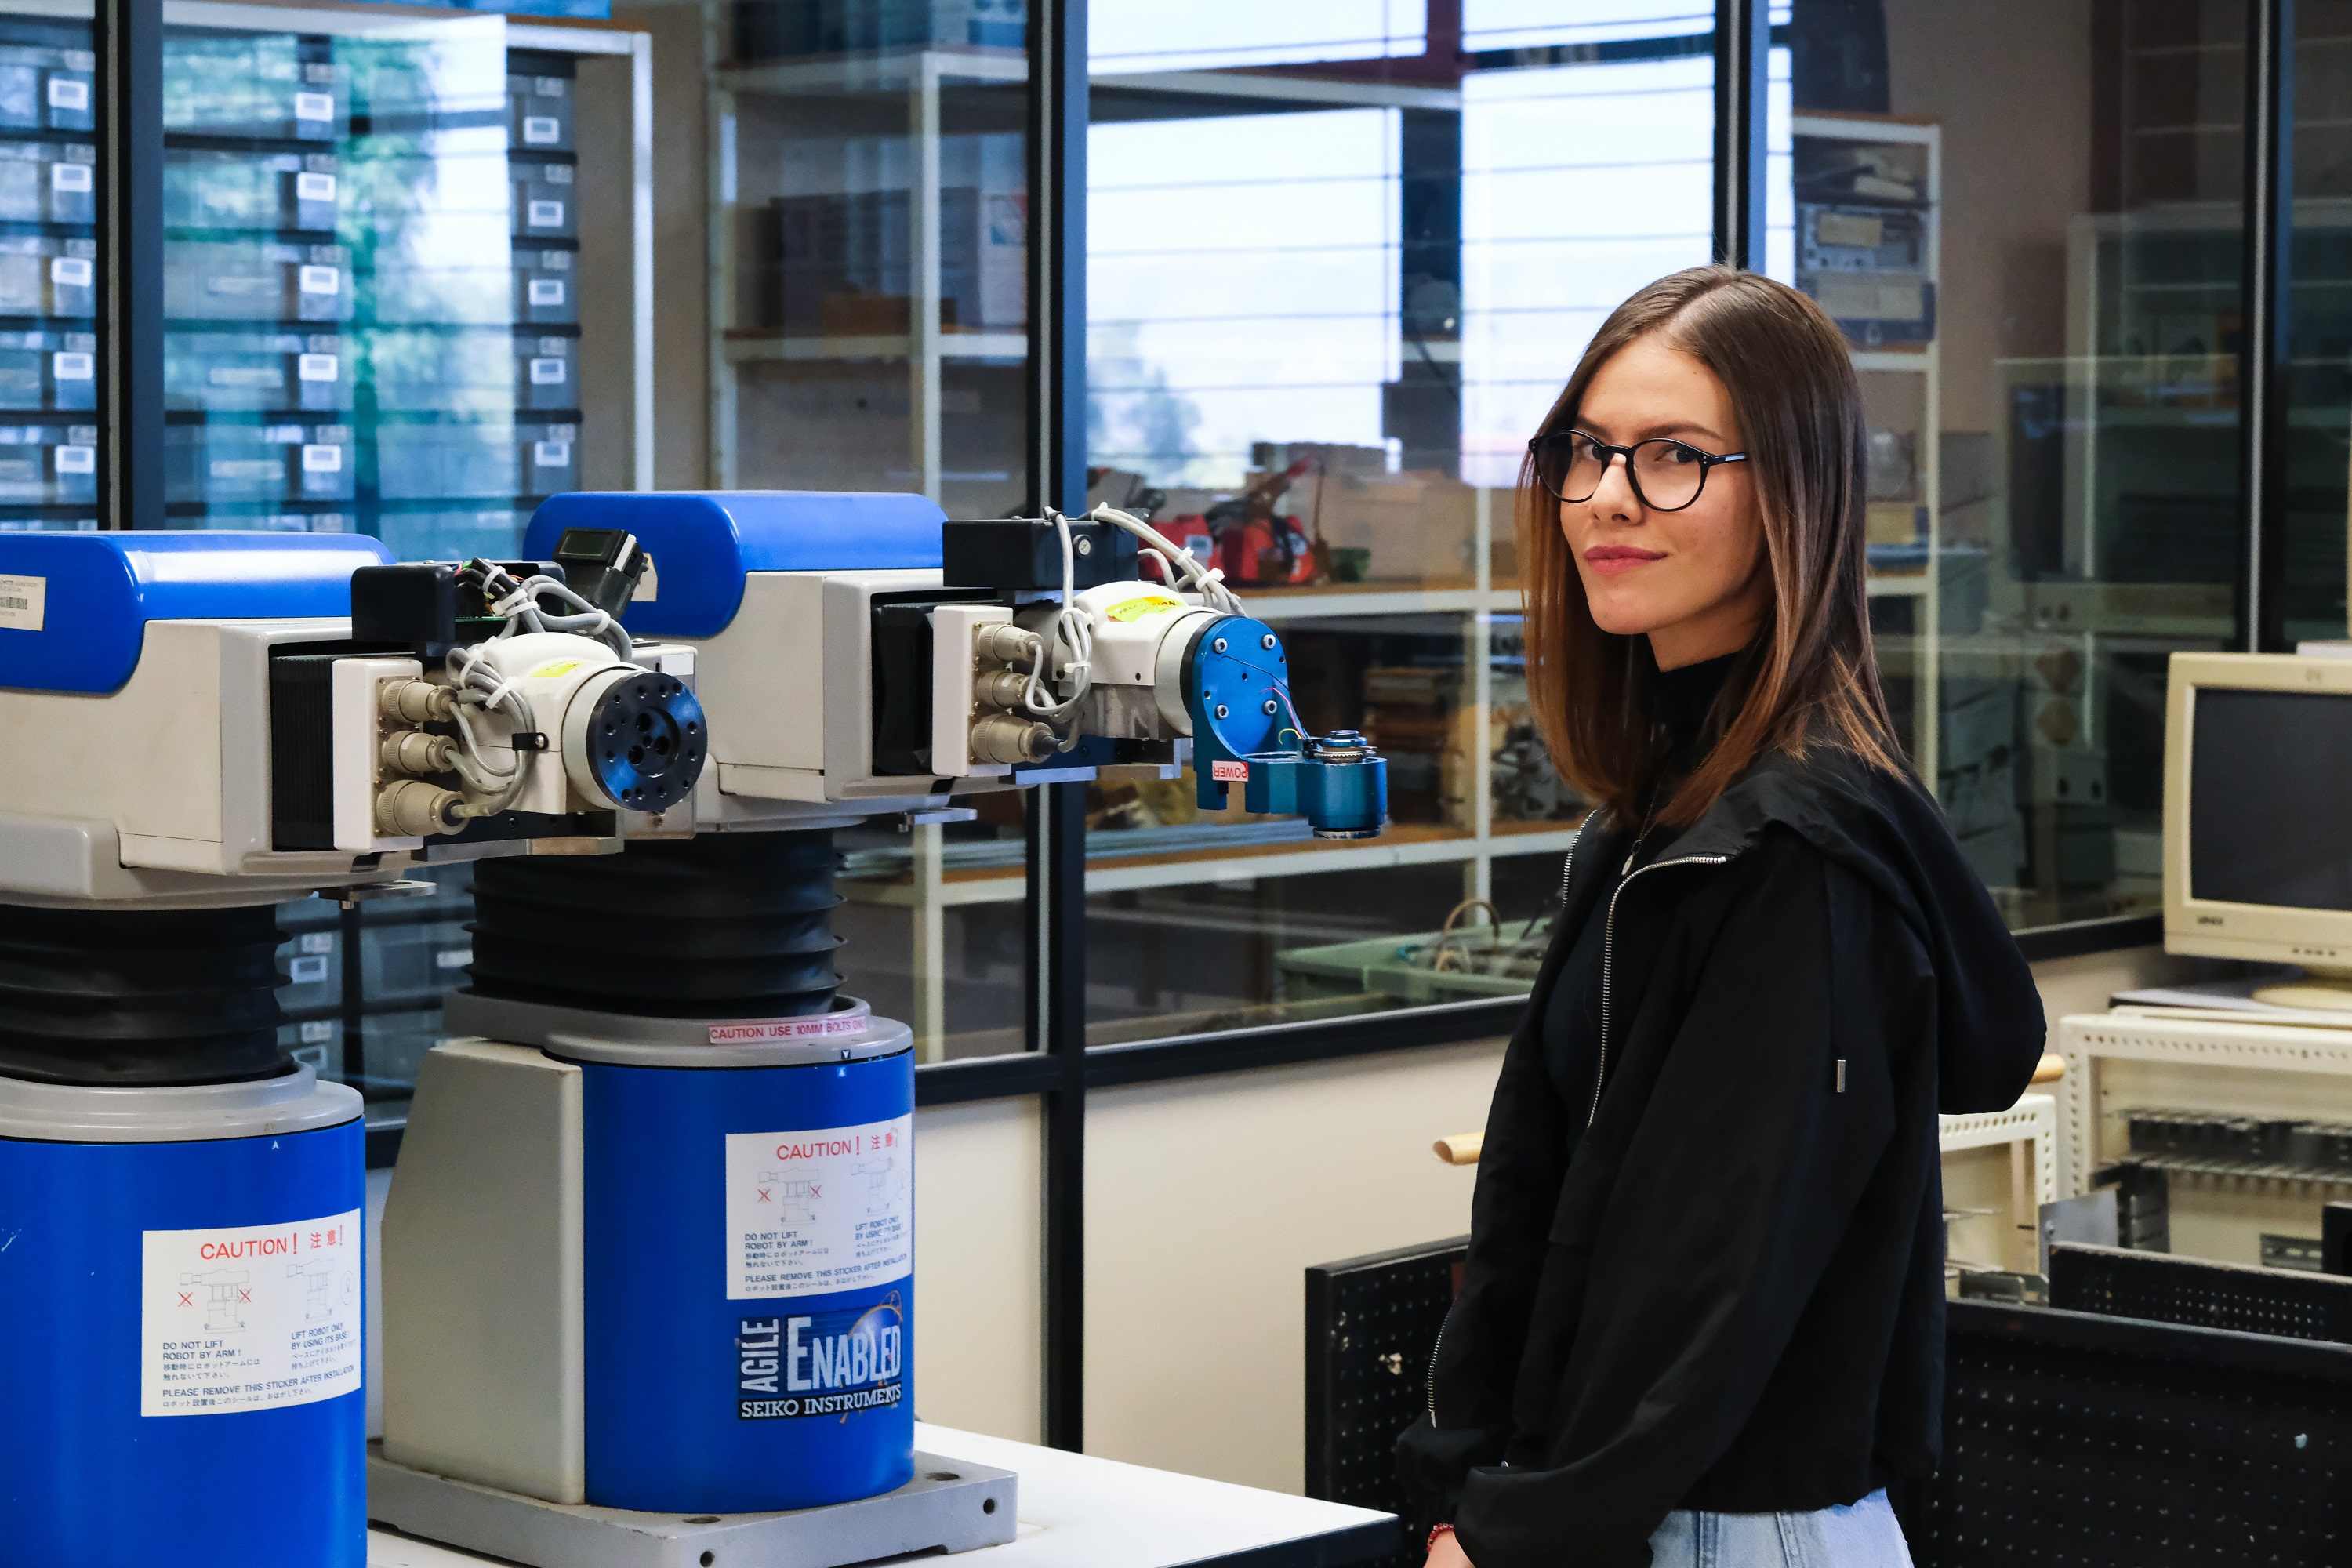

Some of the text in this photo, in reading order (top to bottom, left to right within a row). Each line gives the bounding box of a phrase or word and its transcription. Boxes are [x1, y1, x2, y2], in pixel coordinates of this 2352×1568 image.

[1213, 767, 1247, 778] POWER
[711, 1028, 764, 1039] CAUTION
[770, 1026, 791, 1036] USE
[797, 1024, 822, 1035] 10MM
[826, 1021, 850, 1033] BOLTS
[780, 1272, 813, 1280] REMOVE
[834, 1265, 862, 1276] STICKER
[291, 1330, 306, 1340] LIFT
[309, 1326, 329, 1337] ROBOT
[303, 1338, 323, 1348] USING
[163, 1352, 195, 1360] ROBOT
[741, 1316, 901, 1392] AGILE ENABLED
[163, 1388, 199, 1397] PLEASE
[203, 1385, 241, 1395] REMOVE
[245, 1383, 263, 1392] THIS
[267, 1378, 298, 1390] STICKER
[301, 1374, 321, 1385] AFTER
[742, 1384, 902, 1417] SEIKO INSTRUMENTS
